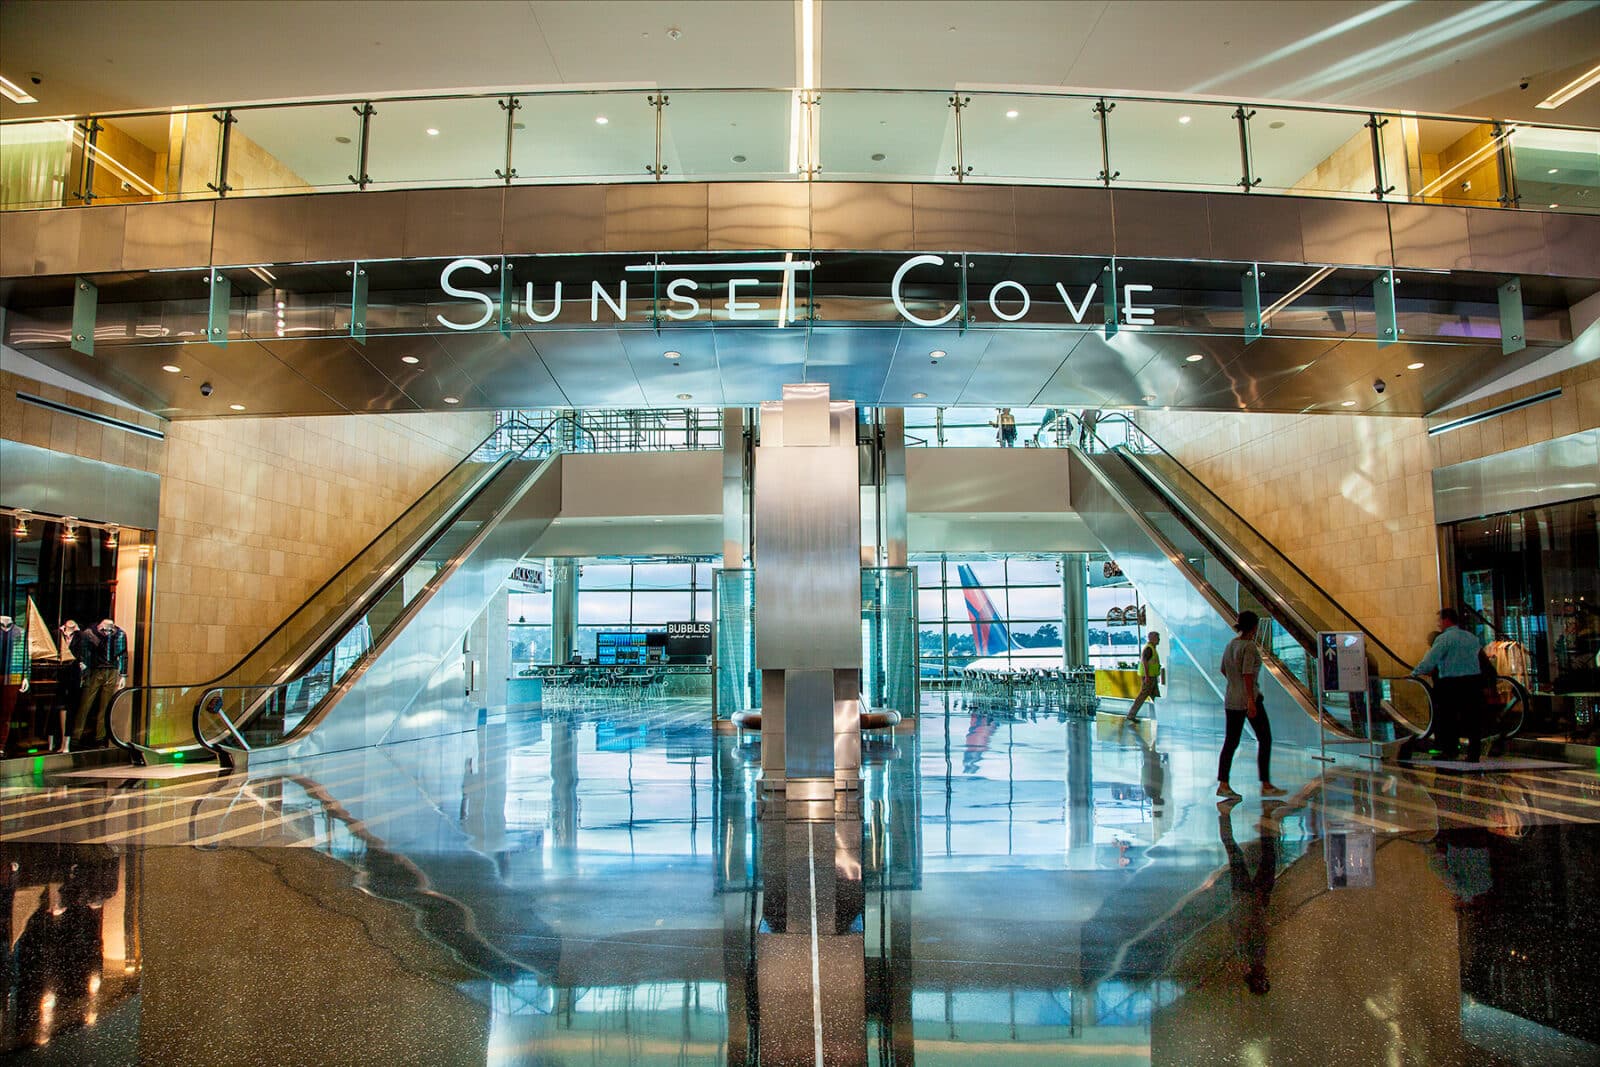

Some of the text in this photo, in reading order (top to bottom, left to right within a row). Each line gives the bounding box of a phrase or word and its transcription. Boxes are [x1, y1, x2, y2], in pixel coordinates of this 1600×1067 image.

[436, 255, 1155, 330] SUNSET COVE
[668, 623, 711, 634] BUBBLES
